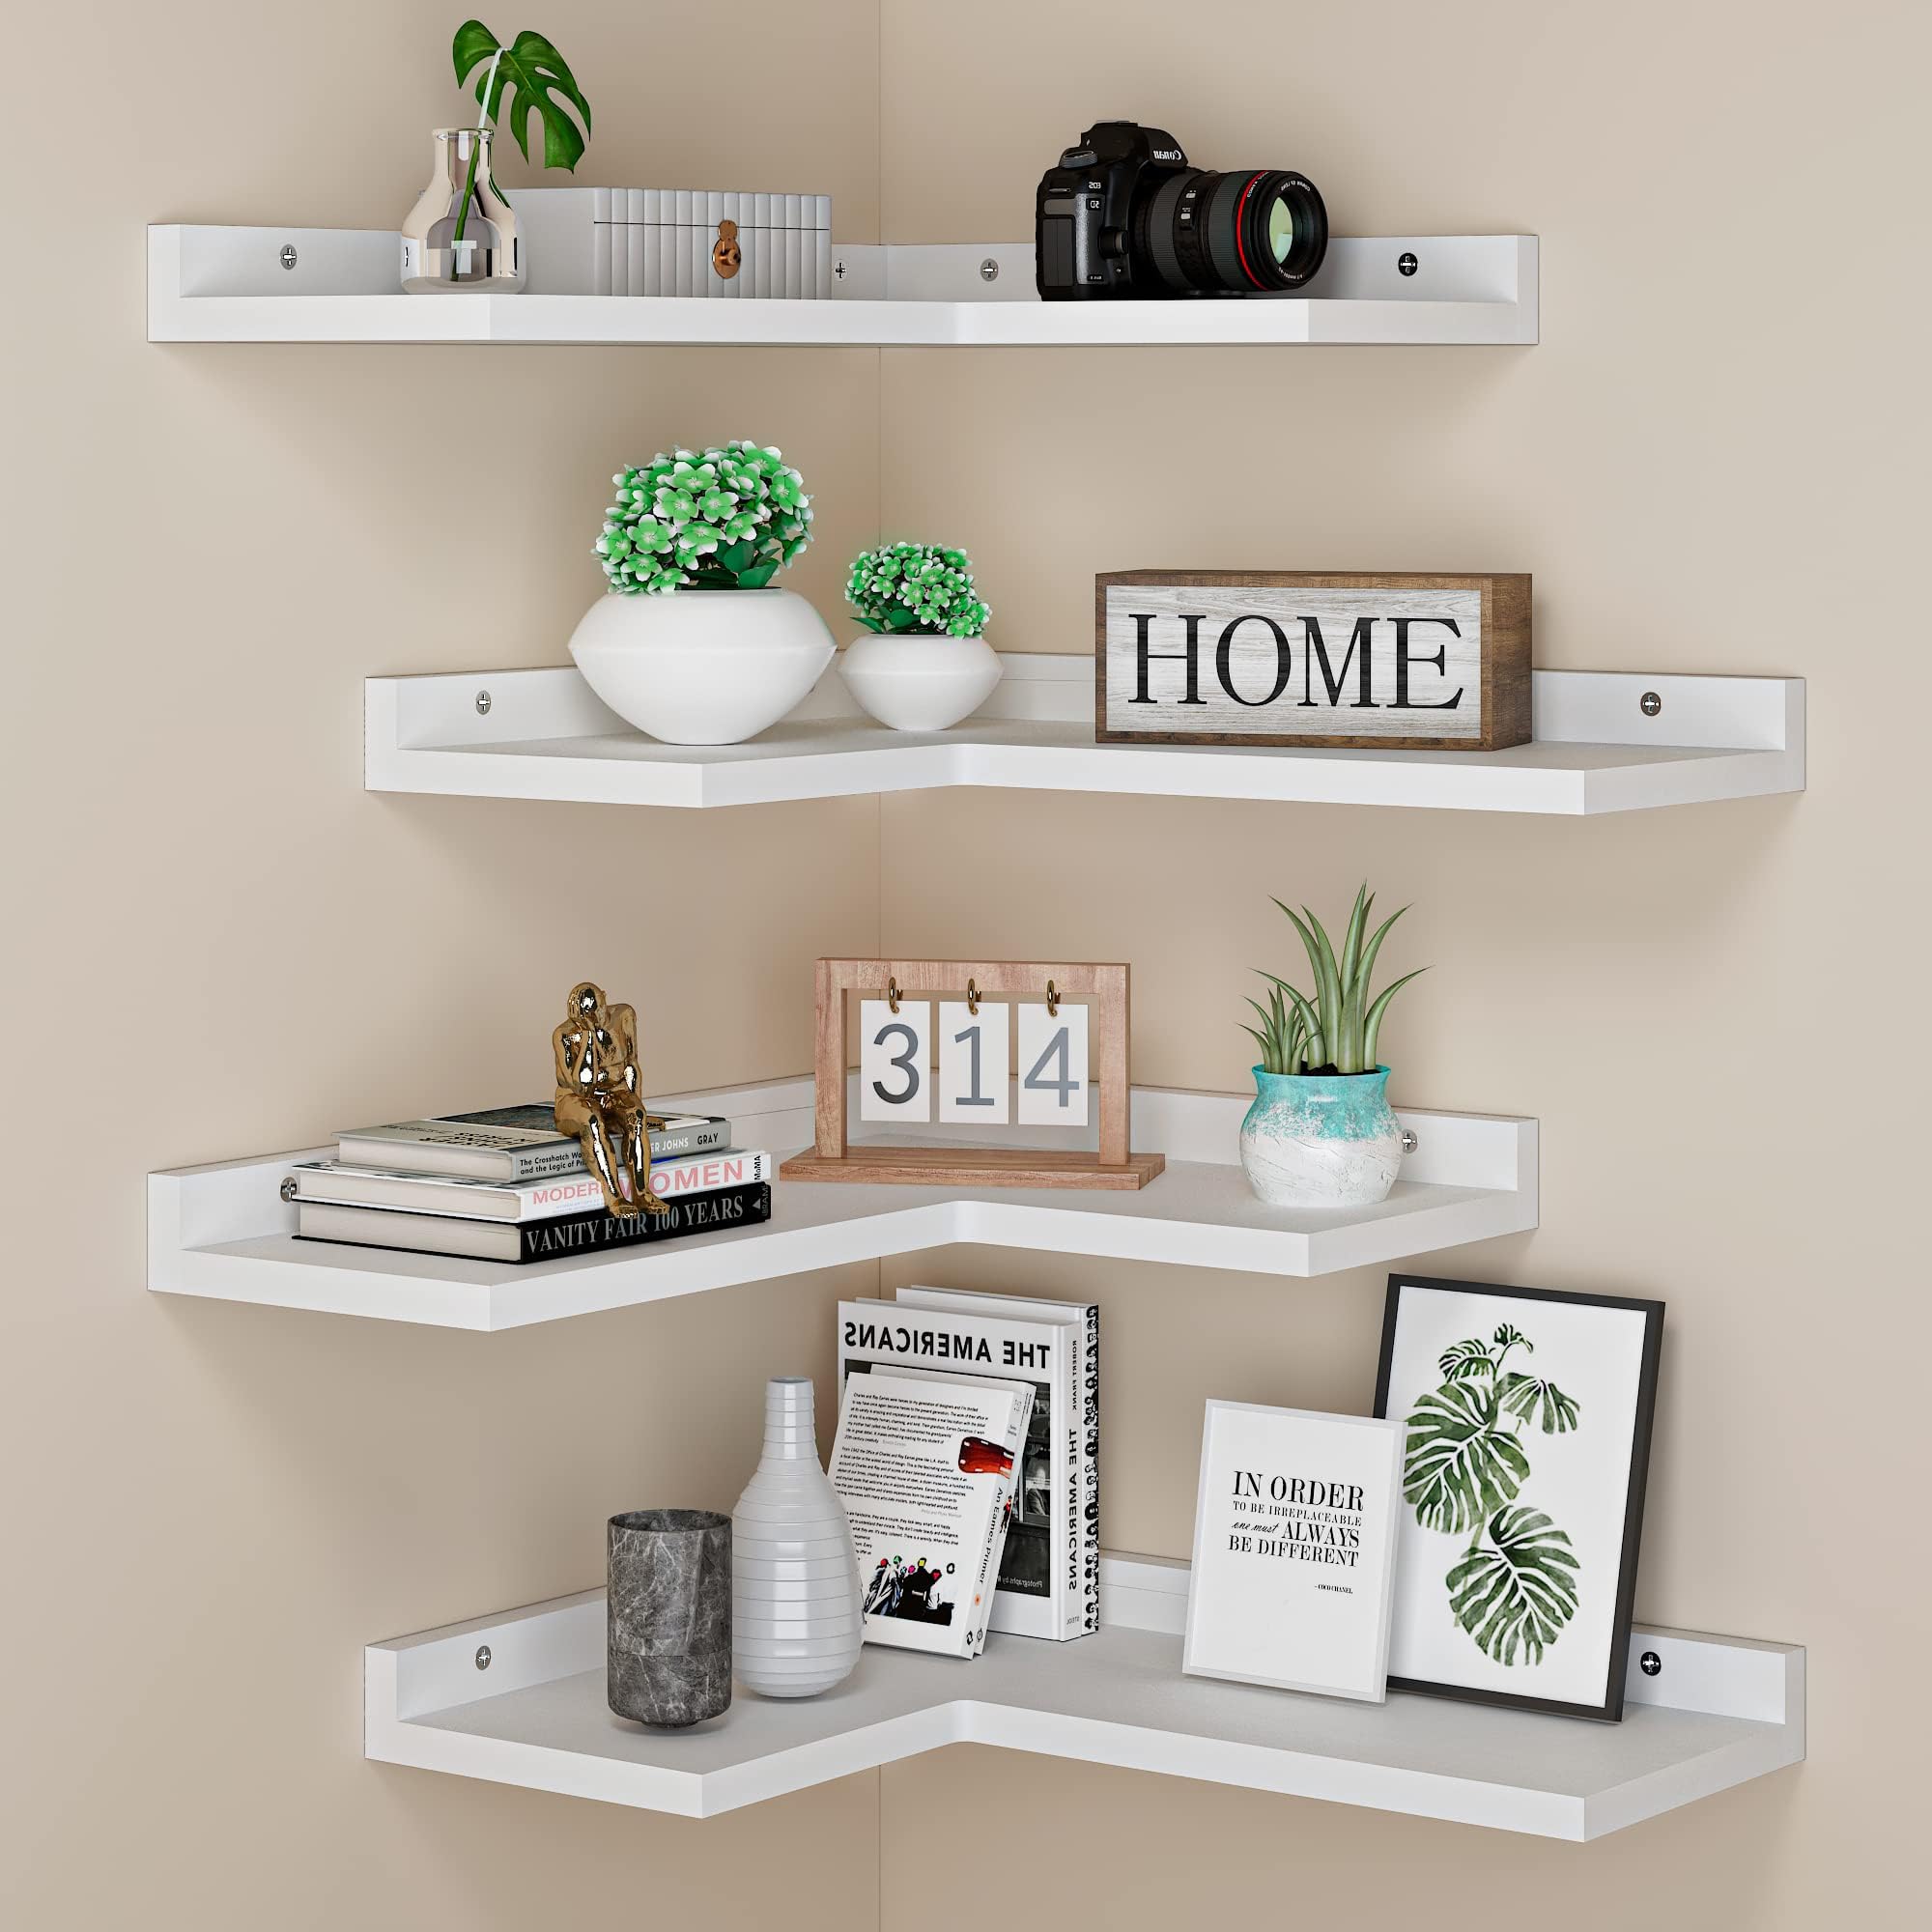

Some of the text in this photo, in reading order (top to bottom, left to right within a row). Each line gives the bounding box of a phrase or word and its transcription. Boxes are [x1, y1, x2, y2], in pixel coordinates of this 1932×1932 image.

[1127, 613, 1464, 710] HOME
[872, 1023, 1080, 1107] 3 1 4
[662, 1137, 689, 1151] JOHNS
[696, 1132, 719, 1145] GRAY
[521, 1166, 534, 1175] and
[549, 1162, 566, 1171] Logic
[532, 1181, 603, 1205] MODER
[526, 1195, 743, 1253] VANITY FAIR 100 YEARS
[1232, 1470, 1364, 1511] IN ORDER
[1233, 1500, 1362, 1527] TO BE IRREPLACEABLE
[979, 1487, 1004, 1585] An Eames Primer
[1228, 1534, 1359, 1567] BE DIFFERENT
[1231, 1520, 1359, 1548] one must ALWAYS
